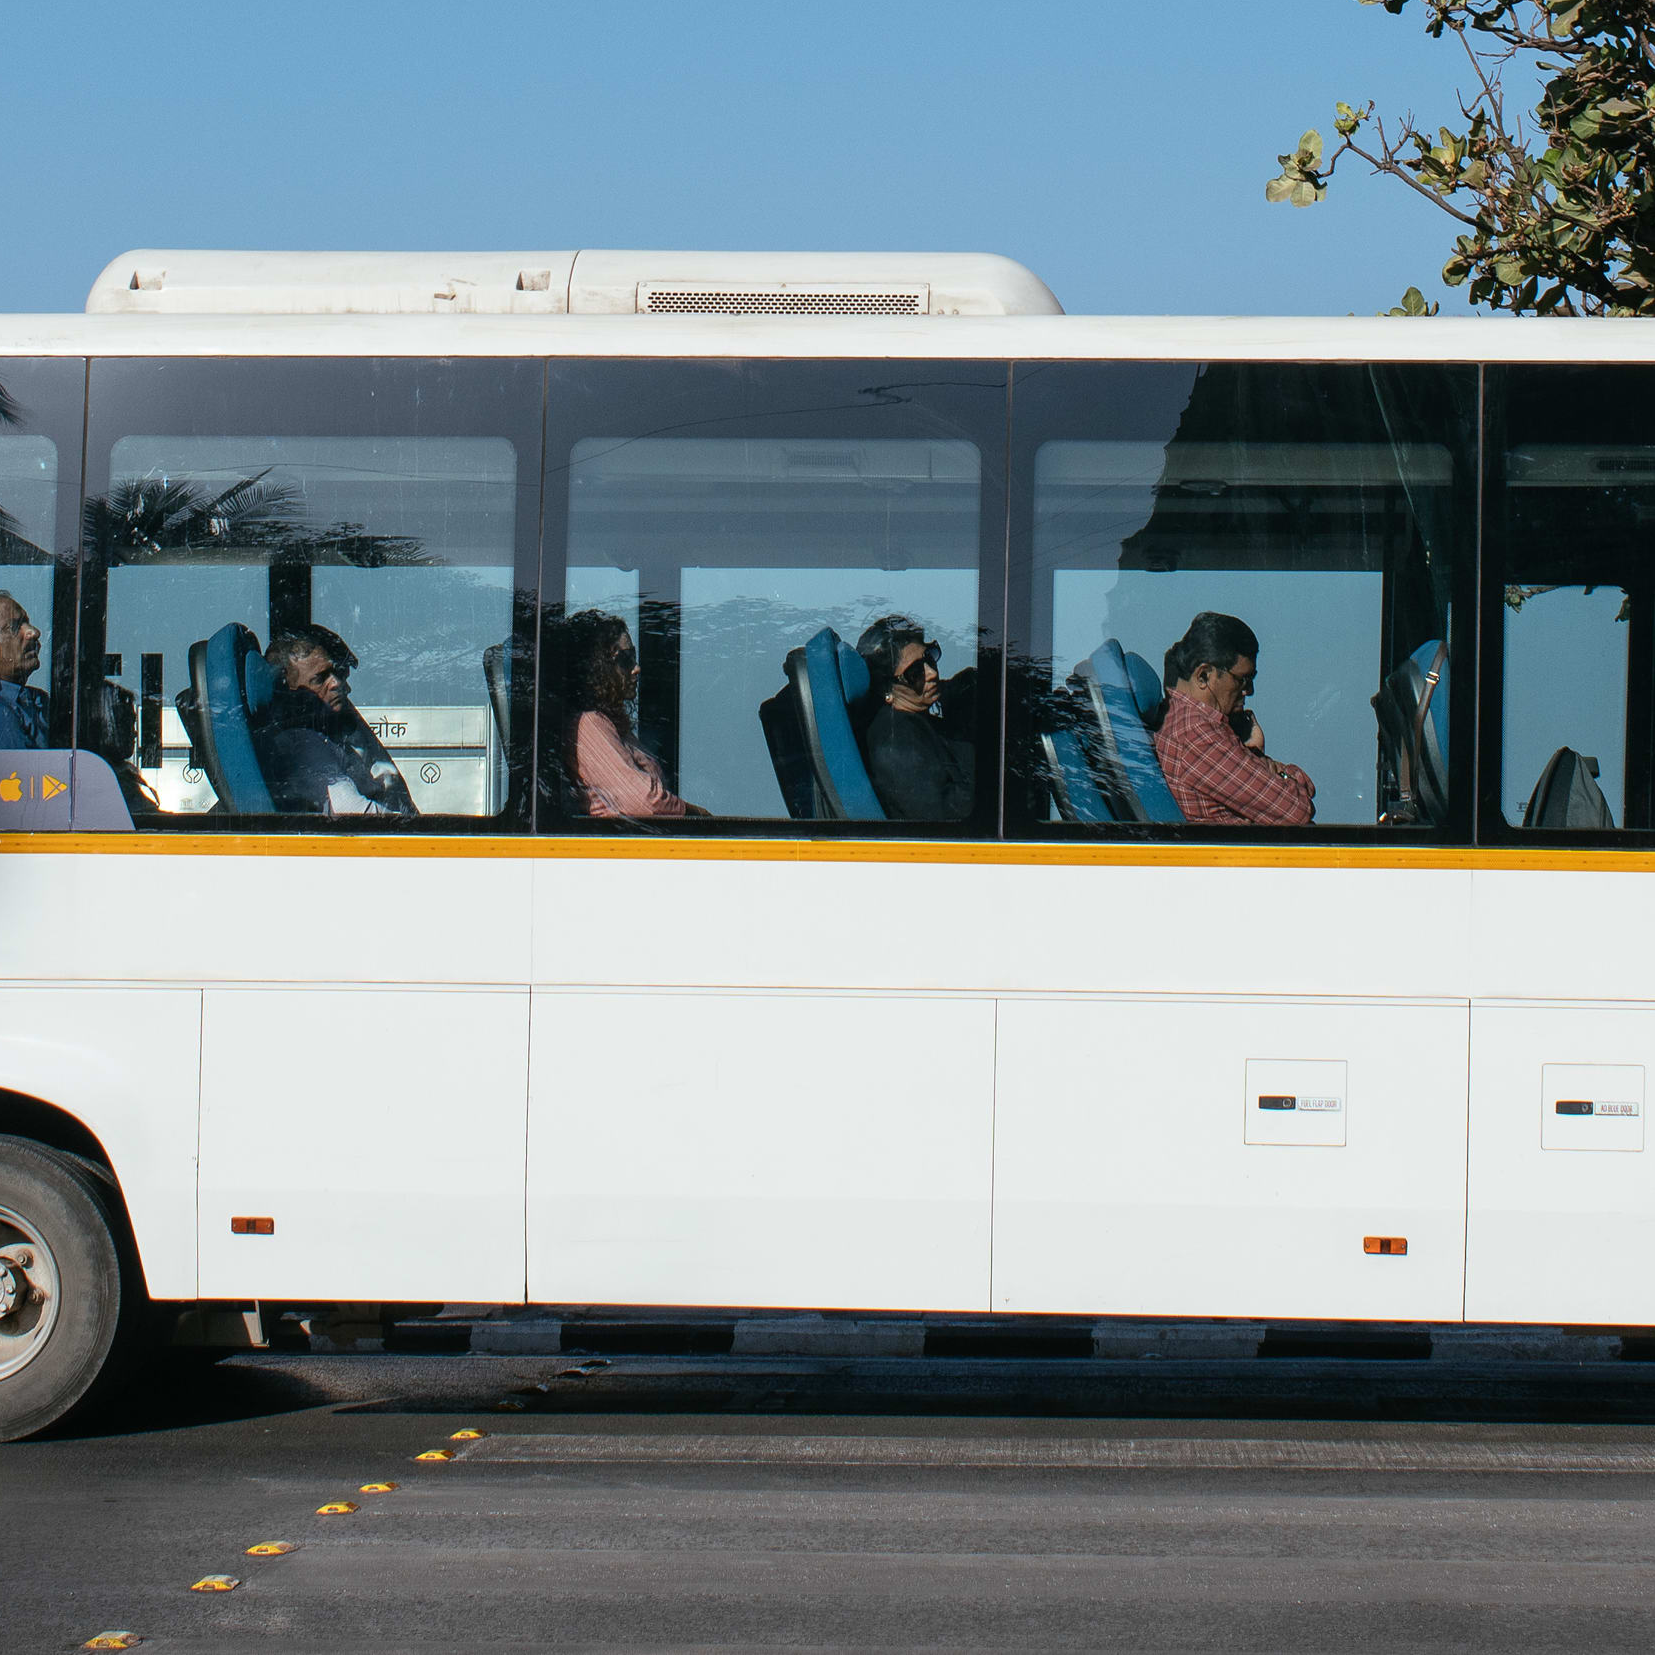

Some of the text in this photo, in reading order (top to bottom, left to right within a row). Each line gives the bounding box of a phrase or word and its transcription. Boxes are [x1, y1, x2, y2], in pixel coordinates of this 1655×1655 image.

[1301, 1099, 1337, 1108] FUEL FLAP DOOR
[1620, 1104, 1633, 1113] DOOR
